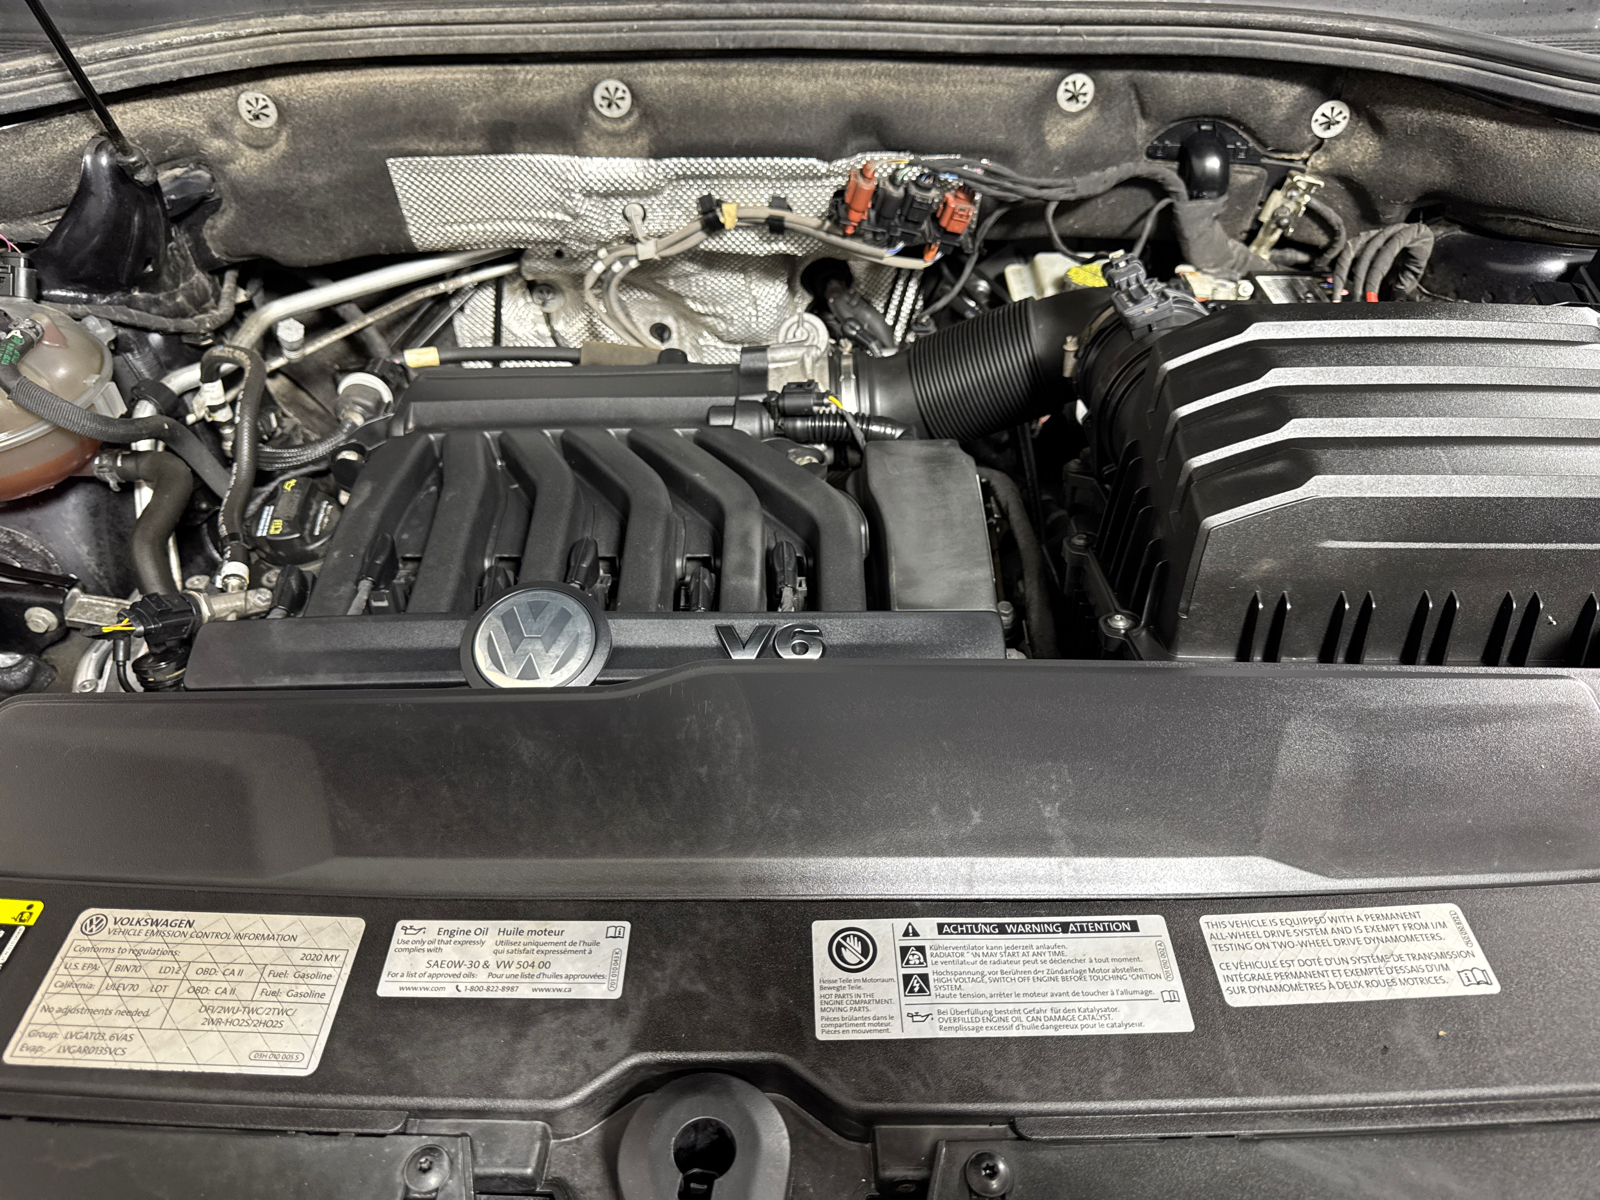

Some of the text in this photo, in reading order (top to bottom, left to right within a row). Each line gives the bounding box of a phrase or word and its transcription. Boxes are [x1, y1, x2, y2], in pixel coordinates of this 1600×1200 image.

[715, 623, 825, 660] V6
[113, 917, 196, 929] VOLKSWAGEN
[1205, 911, 1421, 929] THIS VEHICLE IS EQUIPPED WITH A PERMANENT
[437, 926, 489, 938] Engine Oil
[497, 927, 565, 937] Huile moteur
[942, 921, 1131, 934] ACHTUNG WARNING ATTENTION
[1209, 920, 1448, 941] ALL-WHEEL DRIVE SYSTEM AND IS EXEMPT FROM I/M
[108, 927, 298, 942] VEHICLE EMISSION CONTROL INFORMATION
[411, 938, 426, 946] only
[453, 939, 486, 948] expressly
[523, 940, 567, 949] uniquement
[1212, 932, 1446, 952] TESTING ON TWO-WHEEL DRIVE DYNAMOMETERS.
[73, 944, 181, 957] Conforms to regulations:
[394, 946, 425, 954] complies
[506, 947, 534, 955] satisfait
[536, 948, 583, 956] expressément
[300, 952, 340, 963] 2020 MY
[1219, 950, 1476, 971] CE VÉHICULE EST DOTÉ D'UN SYSTÈME DE TRANSMISSION
[64, 962, 101, 972] U.S. EPA:
[114, 964, 142, 973] BIN70
[426, 960, 551, 969] SAE0W-30 & VW 504 00
[158, 965, 182, 975] LD12
[195, 967, 244, 977] OBD: CA II
[267, 970, 332, 980] Fuel: Gasoline
[1222, 971, 1273, 983] INTÉGRALE
[1273, 969, 1330, 981] PERMANENT
[1331, 969, 1343, 978] ET
[1344, 965, 1385, 977] EXEMPTÉ
[1385, 964, 1425, 975] D'ESSAIS
[427, 971, 461, 980] approved
[462, 971, 478, 979] oils:
[487, 971, 504, 979] Pour
[536, 972, 563, 980] d'huiles
[564, 972, 608, 981] approuvées:
[953, 976, 987, 984] VOLTAGE,
[53, 979, 95, 991] California:
[105, 982, 140, 992] ULEV70
[150, 985, 169, 994] LDT
[464, 985, 519, 993] 1-800-822-8987
[1227, 976, 1449, 995] SUR DYNAMOMÈTRES À DEUX ROUES MOTRICES.
[187, 986, 236, 996] OBD: CA II
[260, 989, 326, 999] Fuel: Gasoline
[845, 998, 895, 1006] COMPARTMENT.
[40, 1005, 150, 1018] No adjustments needed.
[1011, 1015, 1023, 1023] OIL
[1043, 1014, 1076, 1022] DAMAGE
[28, 1029, 59, 1040] Group:
[109, 1032, 135, 1042] 6VAS
[19, 1043, 44, 1054] Evap:
